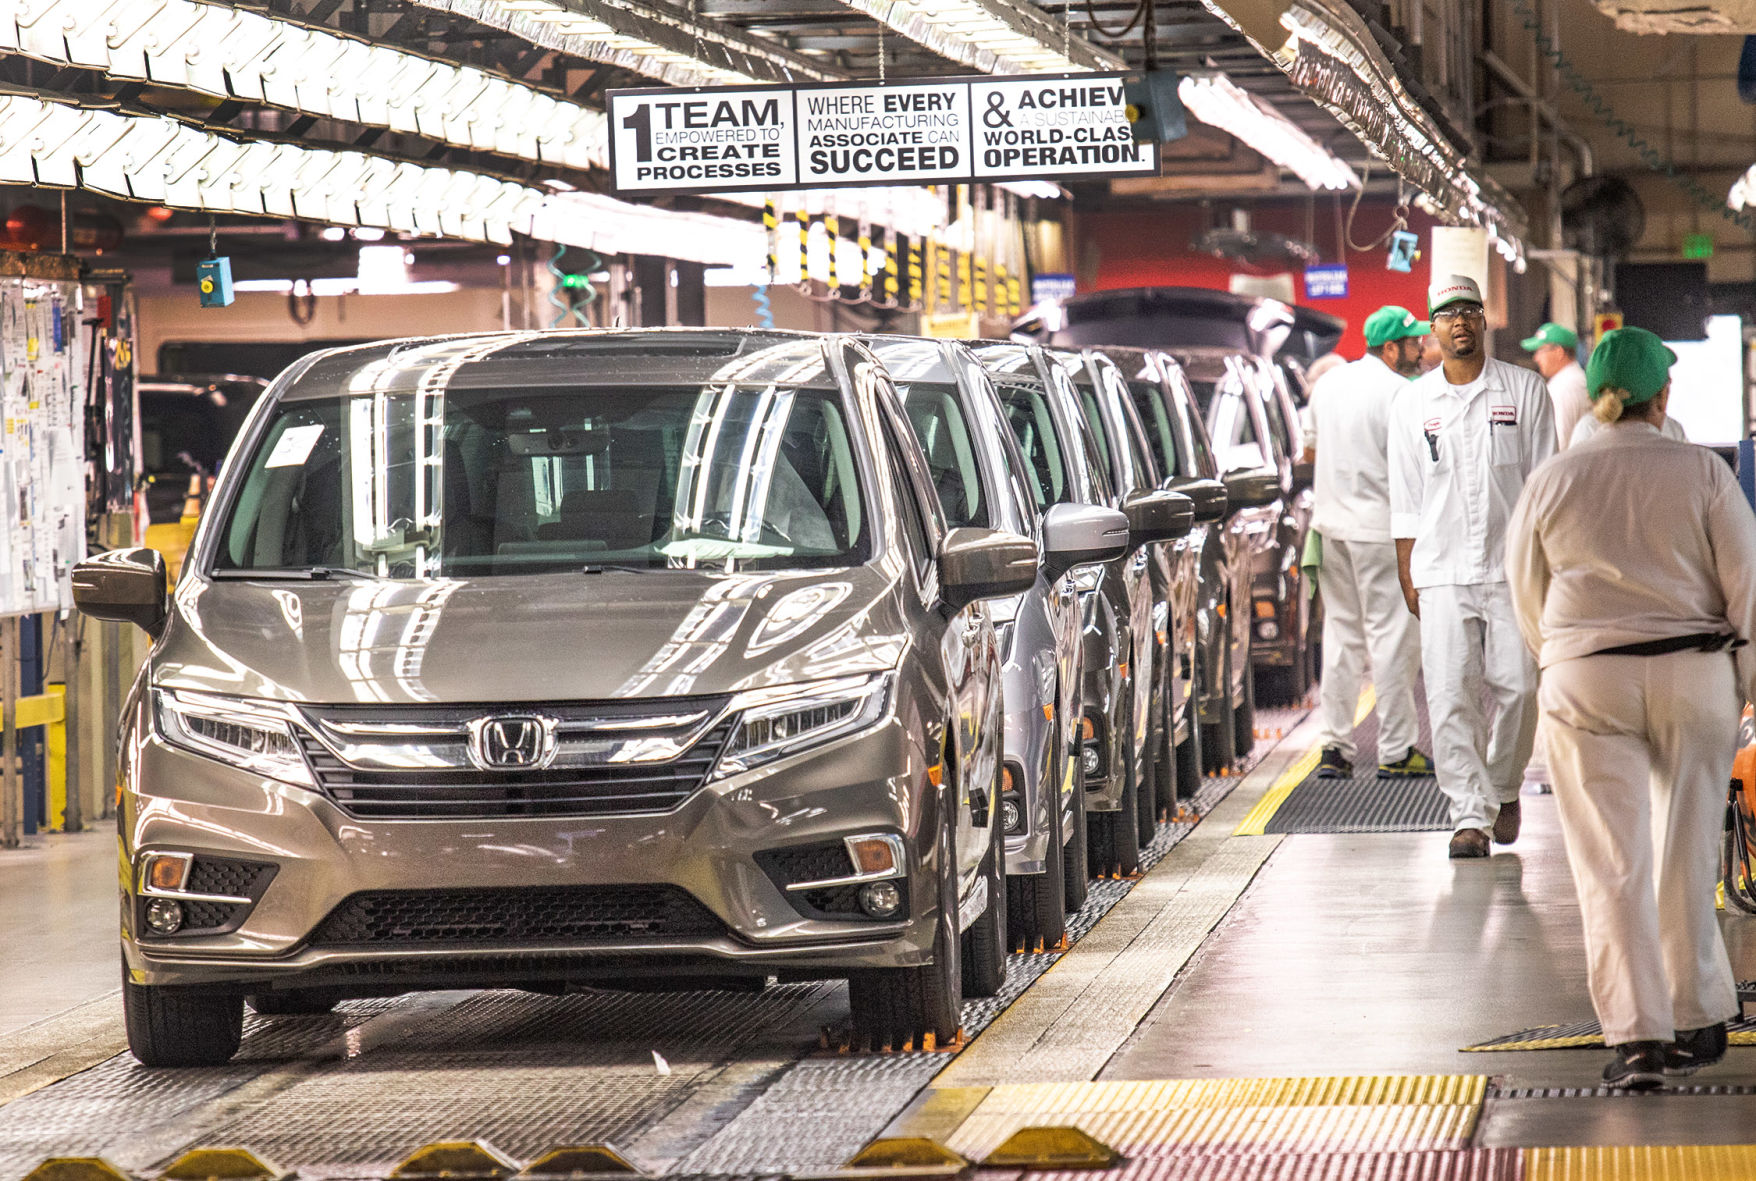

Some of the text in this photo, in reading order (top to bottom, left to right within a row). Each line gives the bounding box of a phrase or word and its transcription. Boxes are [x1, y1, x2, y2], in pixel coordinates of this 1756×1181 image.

[808, 92, 956, 115] WHERE EVERY
[983, 86, 1124, 128] & ACHIEV
[808, 113, 959, 131] MANUFACTURING
[1020, 109, 1130, 127] A SUSTAINAB
[623, 99, 784, 162] 1 TEAM,
[656, 128, 780, 144] EMPOWERED TO
[809, 130, 959, 148] ASSOCIATE CAN
[984, 126, 1133, 146] WORLD-CLAS
[657, 143, 780, 162] CREATE
[810, 145, 959, 174] SUCCEED
[984, 144, 1146, 168] OPERATION.
[637, 162, 782, 180] PROCESSES
[1437, 285, 1474, 297] HONDA
